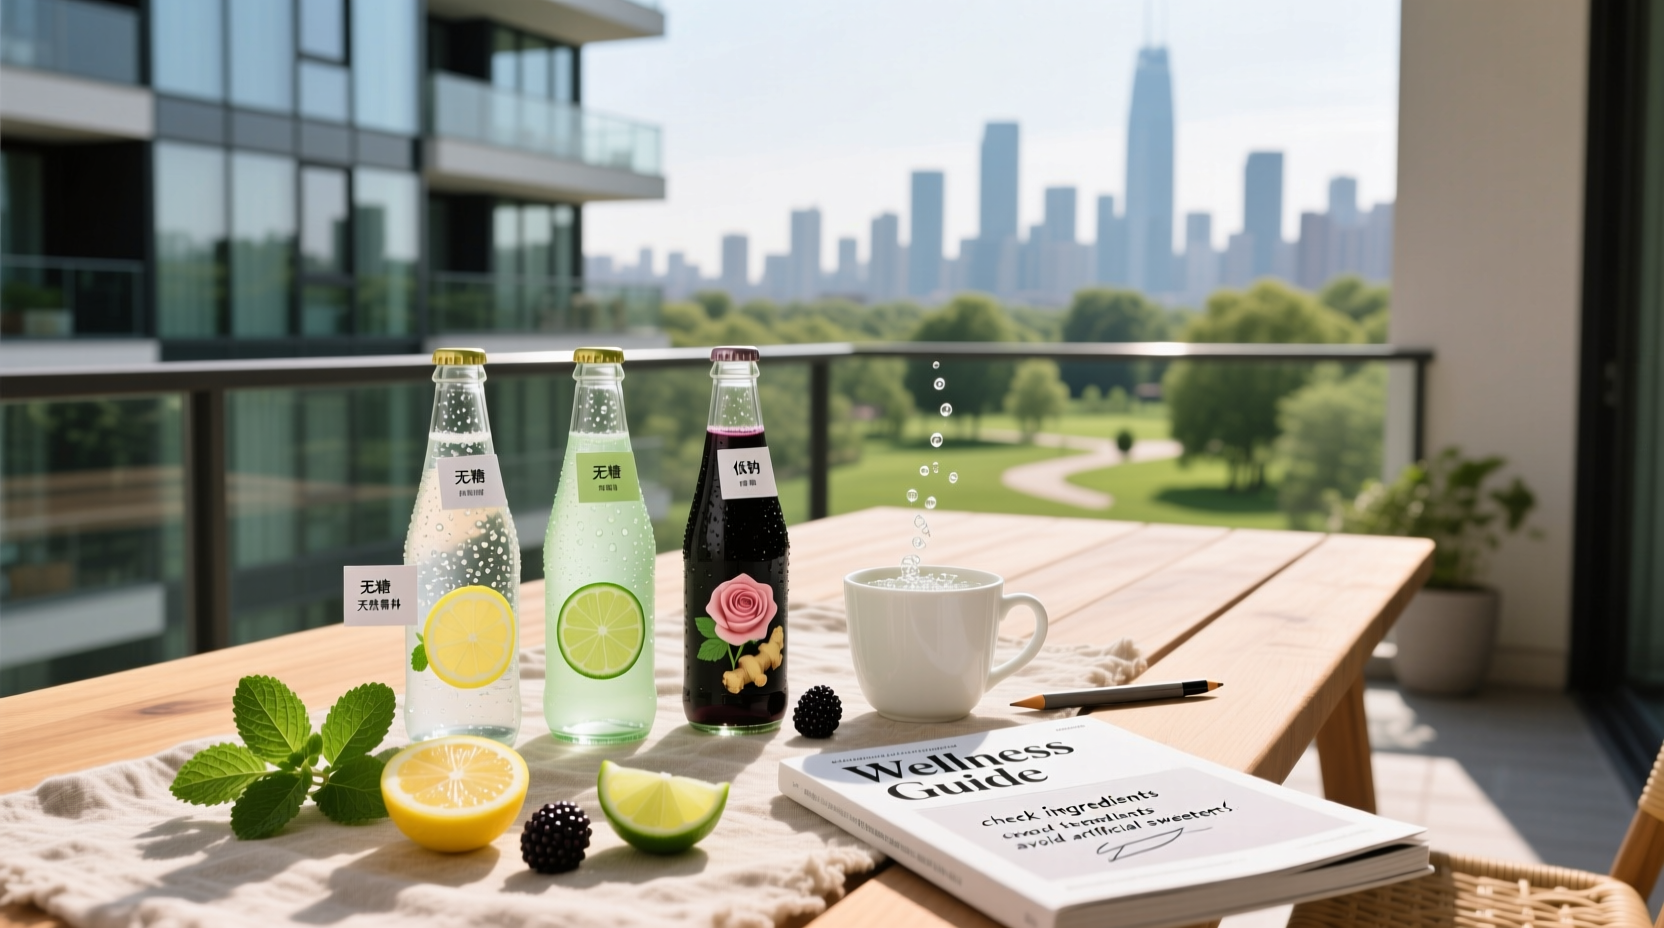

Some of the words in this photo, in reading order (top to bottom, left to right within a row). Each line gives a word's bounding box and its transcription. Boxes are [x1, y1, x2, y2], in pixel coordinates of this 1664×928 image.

[455, 468, 486, 485] 无糖
[360, 578, 391, 595] 无糖
[842, 741, 1075, 783] Wellness
[887, 767, 1049, 801] Guide
[982, 810, 1041, 827] check
